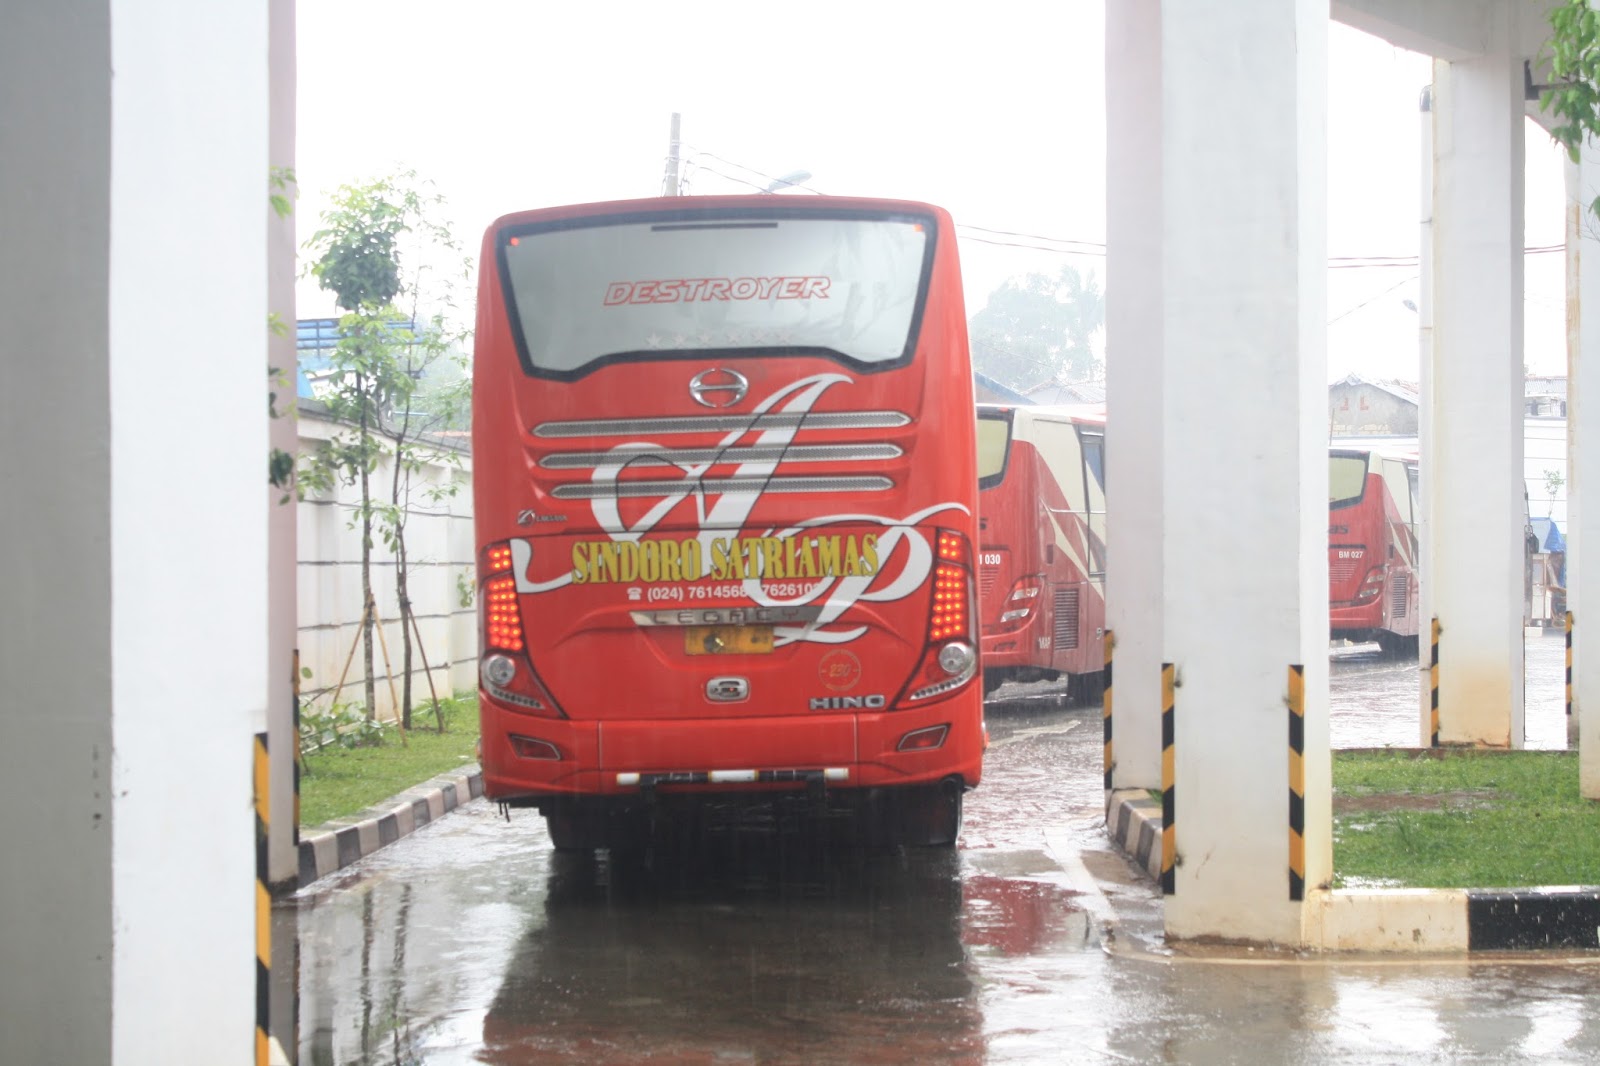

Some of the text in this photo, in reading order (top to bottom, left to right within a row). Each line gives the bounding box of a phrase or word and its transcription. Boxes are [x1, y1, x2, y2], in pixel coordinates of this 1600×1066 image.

[604, 276, 831, 306] DESTROYER
[571, 532, 879, 585] SINDORO SATRIAMAS
[985, 554, 1001, 565] 030
[1351, 551, 1363, 559] 027
[647, 586, 684, 602] (024)
[652, 607, 800, 626] LEGACY
[808, 694, 886, 710] HINO
